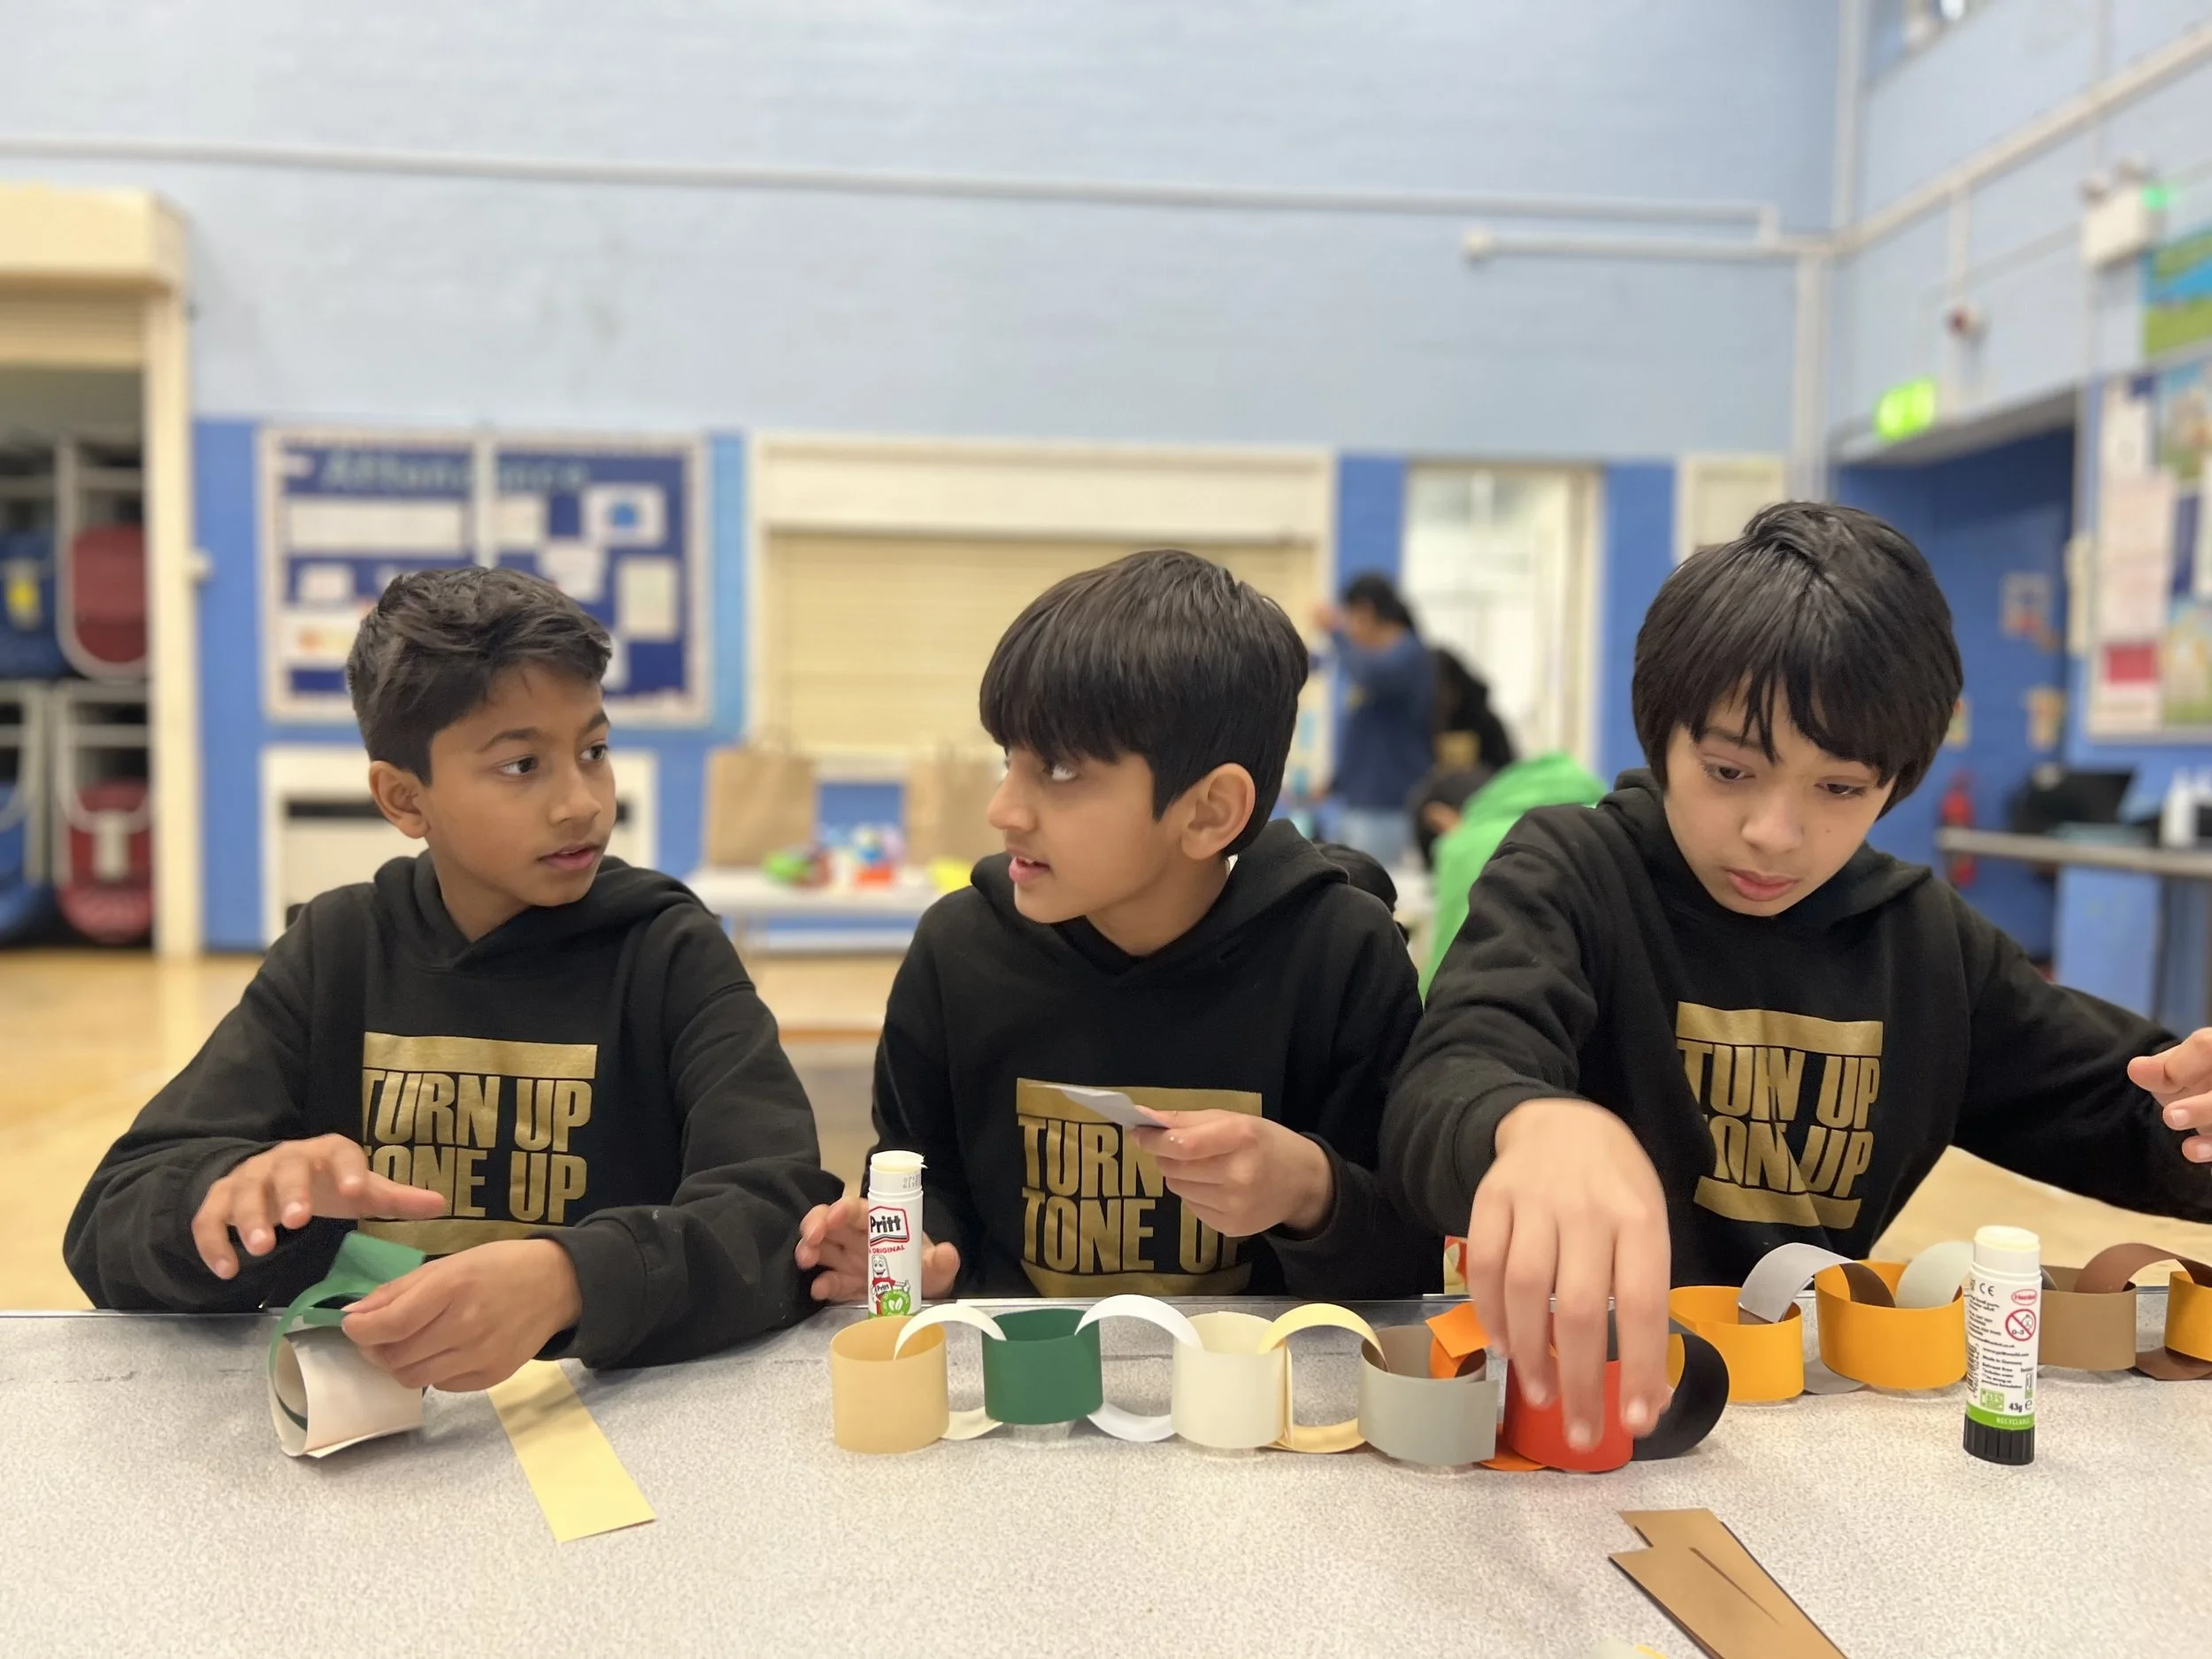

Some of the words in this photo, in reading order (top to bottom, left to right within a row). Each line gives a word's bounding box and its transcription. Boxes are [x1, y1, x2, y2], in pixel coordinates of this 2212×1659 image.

[362, 1068, 501, 1148] TURN
[514, 1078, 593, 1152] UP
[1816, 1055, 1880, 1130] UP
[363, 1144, 488, 1217] ONE
[509, 1150, 588, 1224] UP
[1018, 1113, 1164, 1198] TURN
[1798, 1124, 1874, 1198] UP
[870, 1215, 902, 1233] Pritt
[872, 1245, 906, 1255] ORIGINAL
[1022, 1187, 1156, 1274] TONE
[2008, 1402, 2023, 1413] 43g
